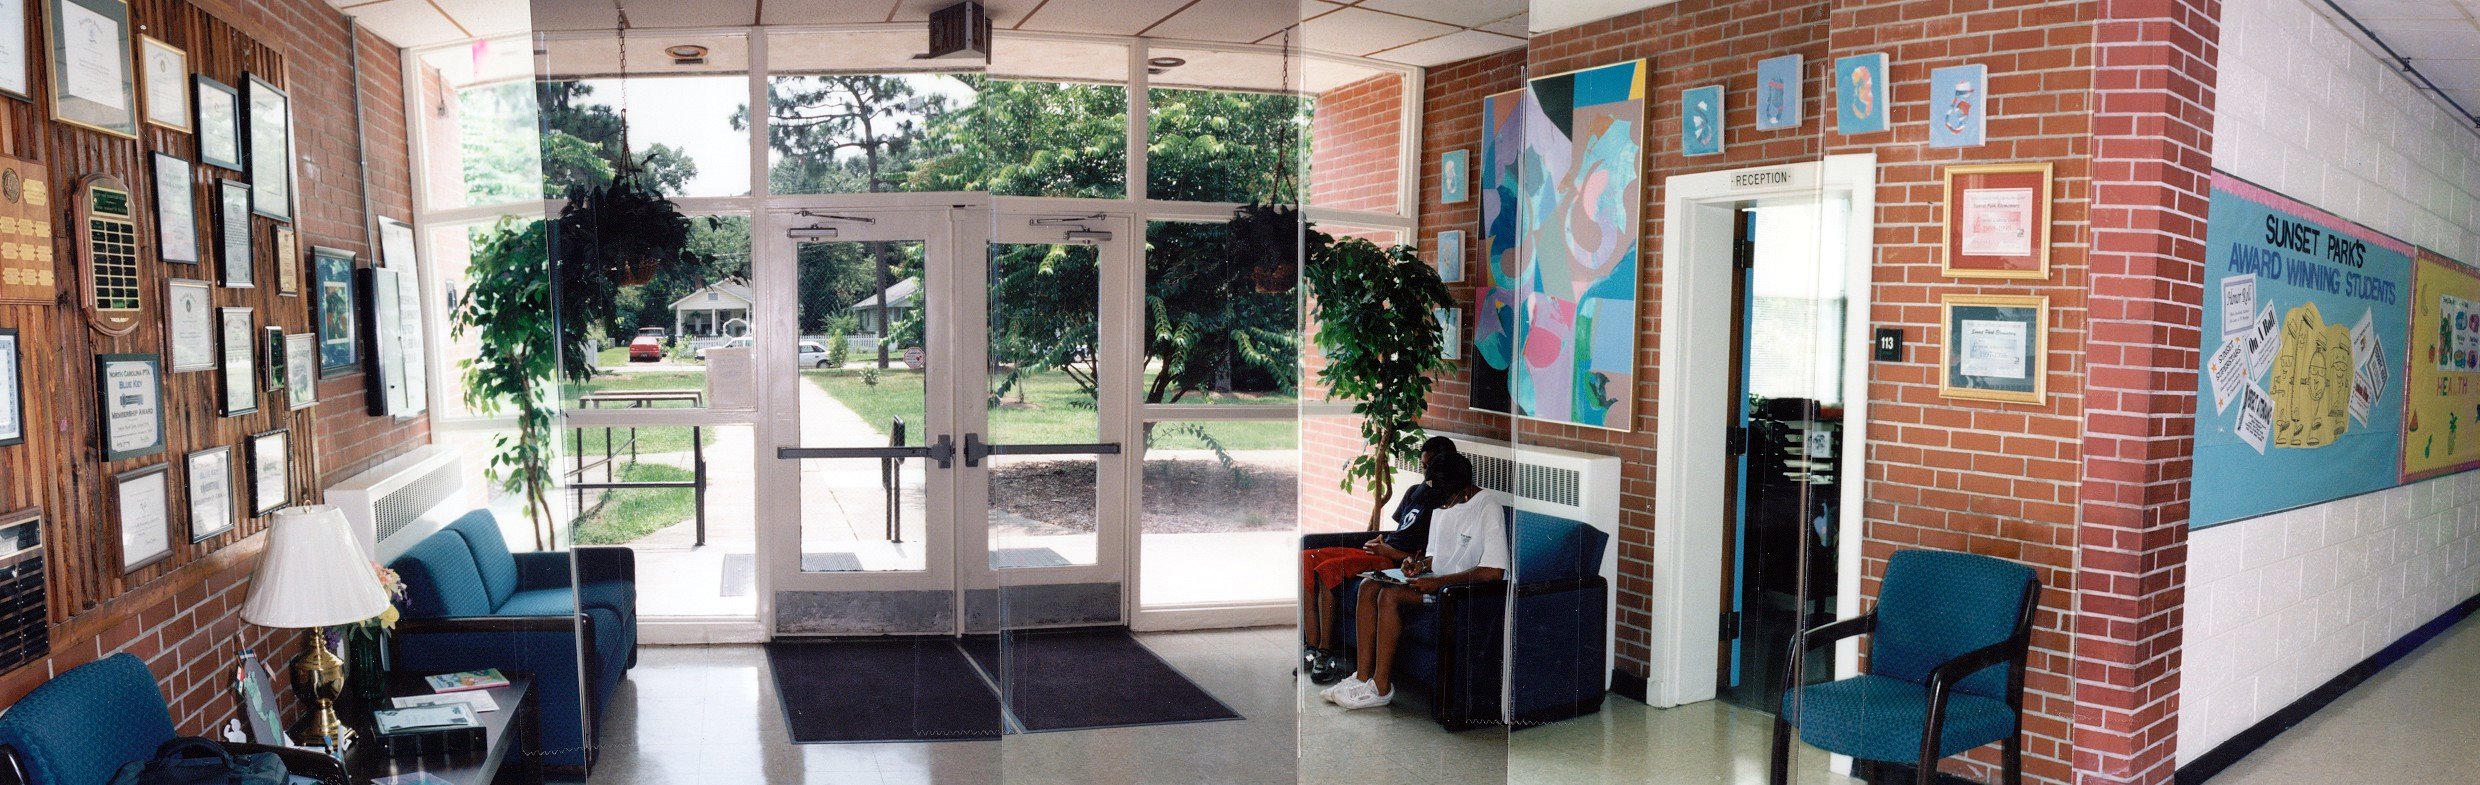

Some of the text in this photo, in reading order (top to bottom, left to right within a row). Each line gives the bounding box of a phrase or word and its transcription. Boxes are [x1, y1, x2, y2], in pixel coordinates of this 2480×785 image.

[1735, 171, 1787, 186] RECEPTION
[2265, 213, 2367, 269] SUNSET PARK'S
[2227, 241, 2397, 306] AWARD WINNING STUDENTS
[1881, 336, 1894, 350] 113
[119, 380, 143, 389] BLUE KEY
[111, 408, 154, 419] MEMBERSHIP AWARD
